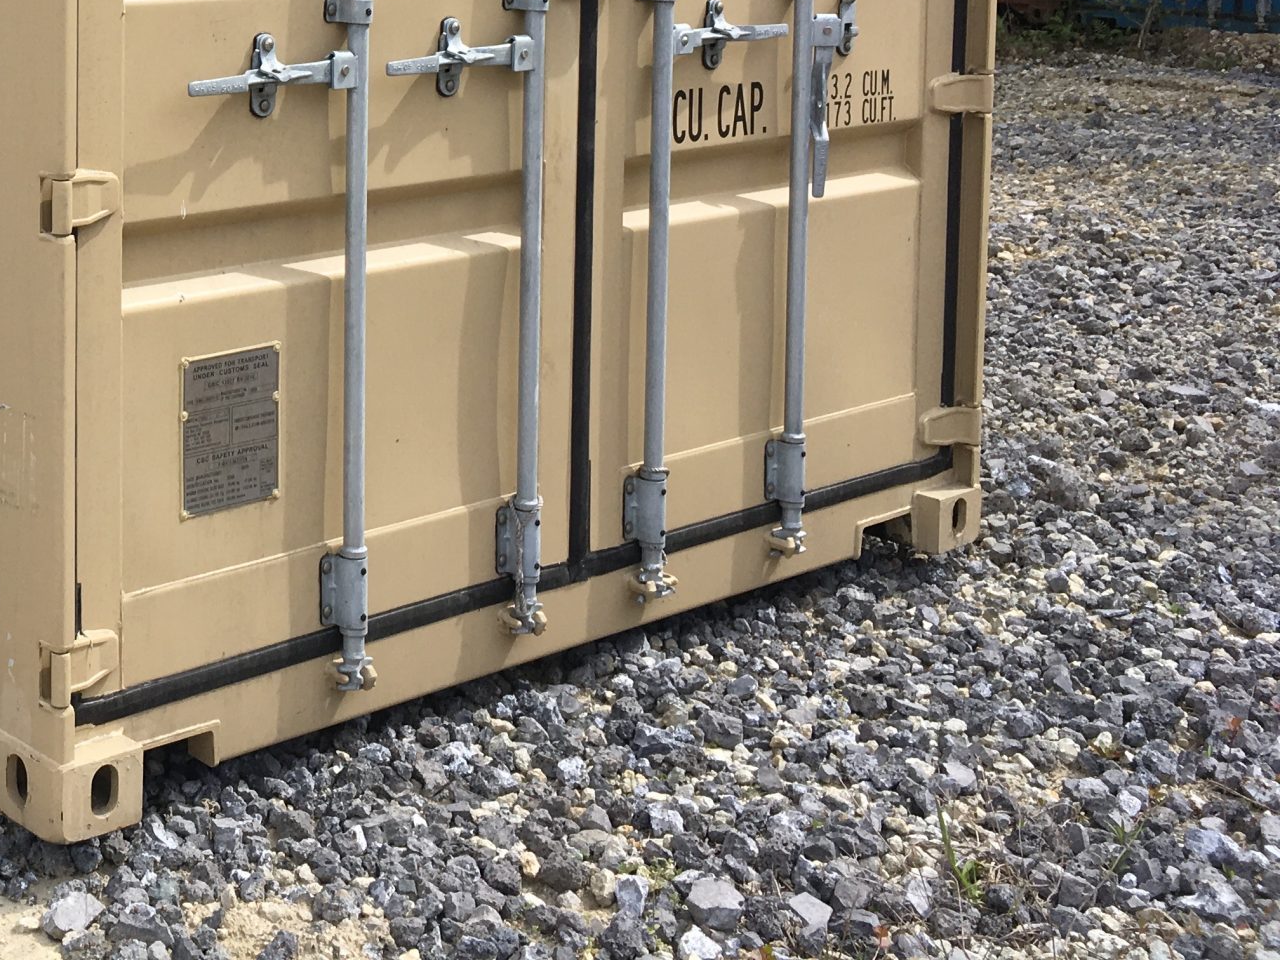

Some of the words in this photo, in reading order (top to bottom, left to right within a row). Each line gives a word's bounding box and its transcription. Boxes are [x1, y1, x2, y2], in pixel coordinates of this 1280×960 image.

[673, 87, 709, 144] CU.
[717, 81, 767, 138] CAP.
[831, 72, 852, 100] 3.2
[826, 100, 851, 128] 173
[862, 96, 897, 124] CU.FT.
[193, 362, 222, 373] APPROVED
[224, 360, 235, 368] FOR
[193, 371, 215, 381] UNDER
[219, 365, 249, 376] CUSTOMS
[253, 361, 269, 370] SEAL
[211, 450, 235, 461] SAFETY
[237, 444, 269, 455] APPROVAL
